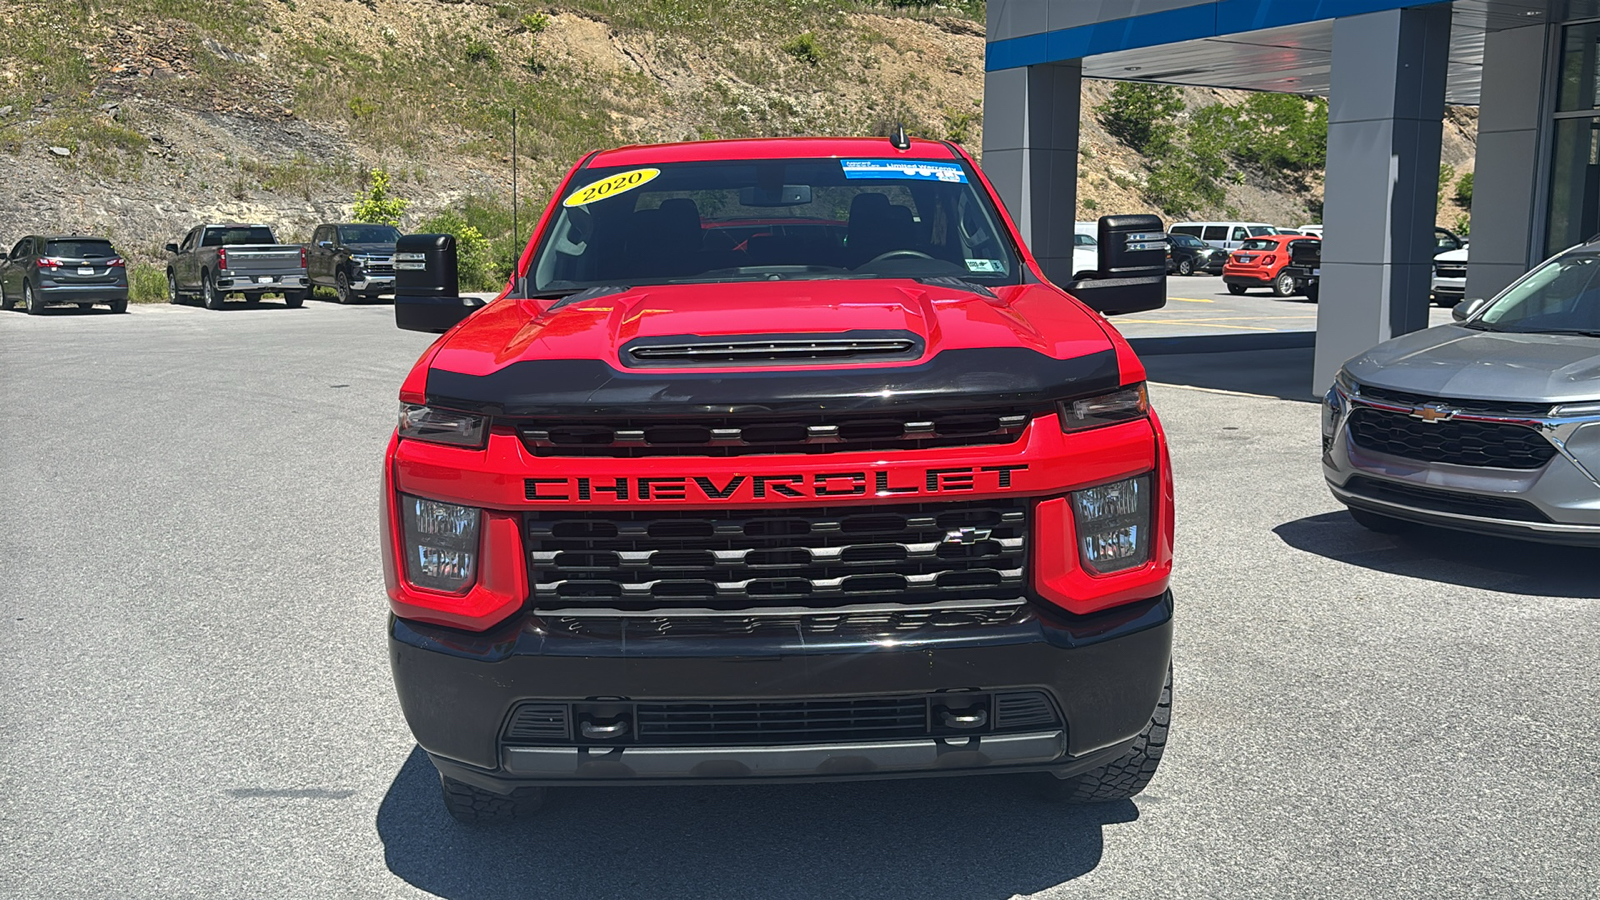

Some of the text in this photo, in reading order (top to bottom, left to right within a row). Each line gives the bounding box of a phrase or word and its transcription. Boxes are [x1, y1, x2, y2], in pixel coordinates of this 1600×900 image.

[886, 162, 917, 170] Limited
[918, 164, 957, 172] Warranty
[583, 172, 642, 202] 2020
[524, 463, 1029, 502] CHEVROLET
